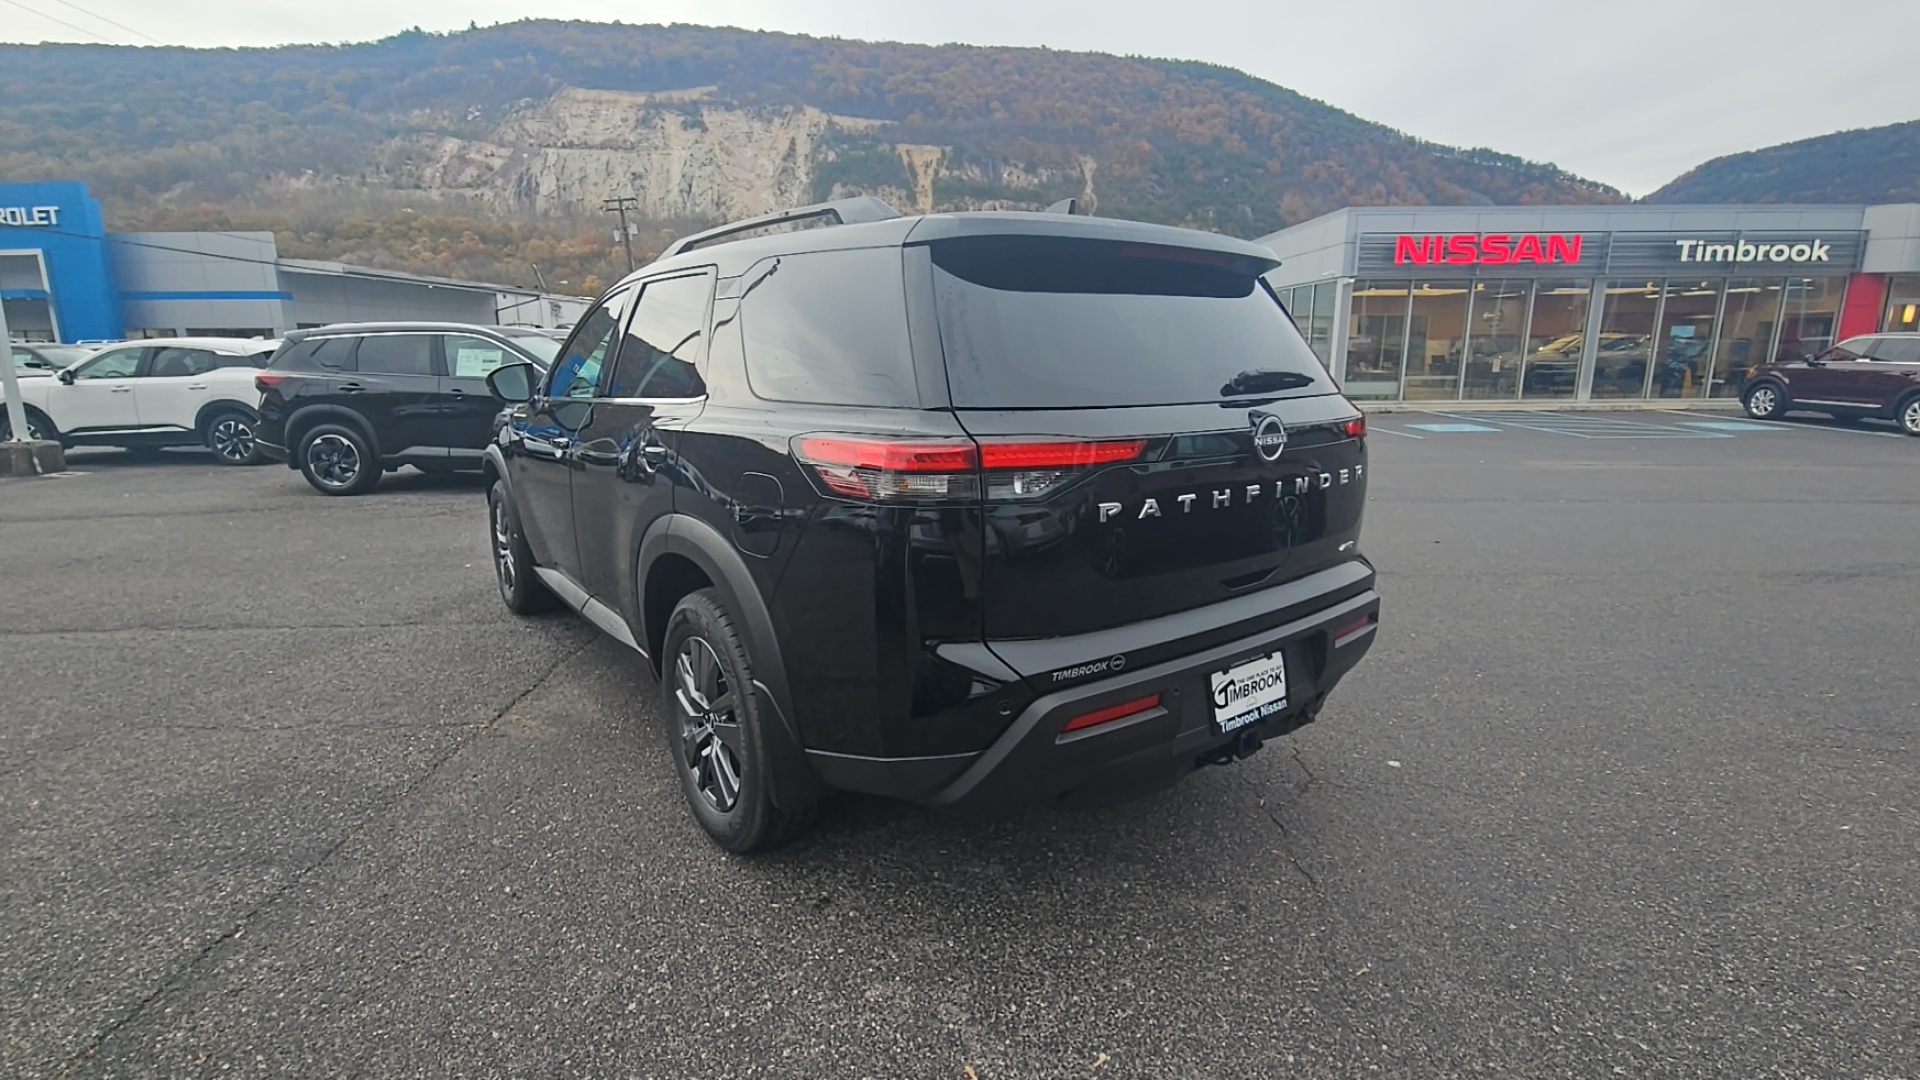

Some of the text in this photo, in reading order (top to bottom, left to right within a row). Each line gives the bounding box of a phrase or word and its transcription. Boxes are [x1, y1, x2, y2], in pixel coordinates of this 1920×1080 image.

[1394, 234, 1583, 265] NISSAN
[1676, 239, 1830, 262] Timbrook
[1254, 433, 1288, 446] NISSAN
[1098, 465, 1364, 523] PATHFINDER
[1052, 661, 1109, 682] TIMBROOK
[1214, 670, 1283, 709] TIMBROOK
[1220, 699, 1288, 734] Timbrook Nissan
